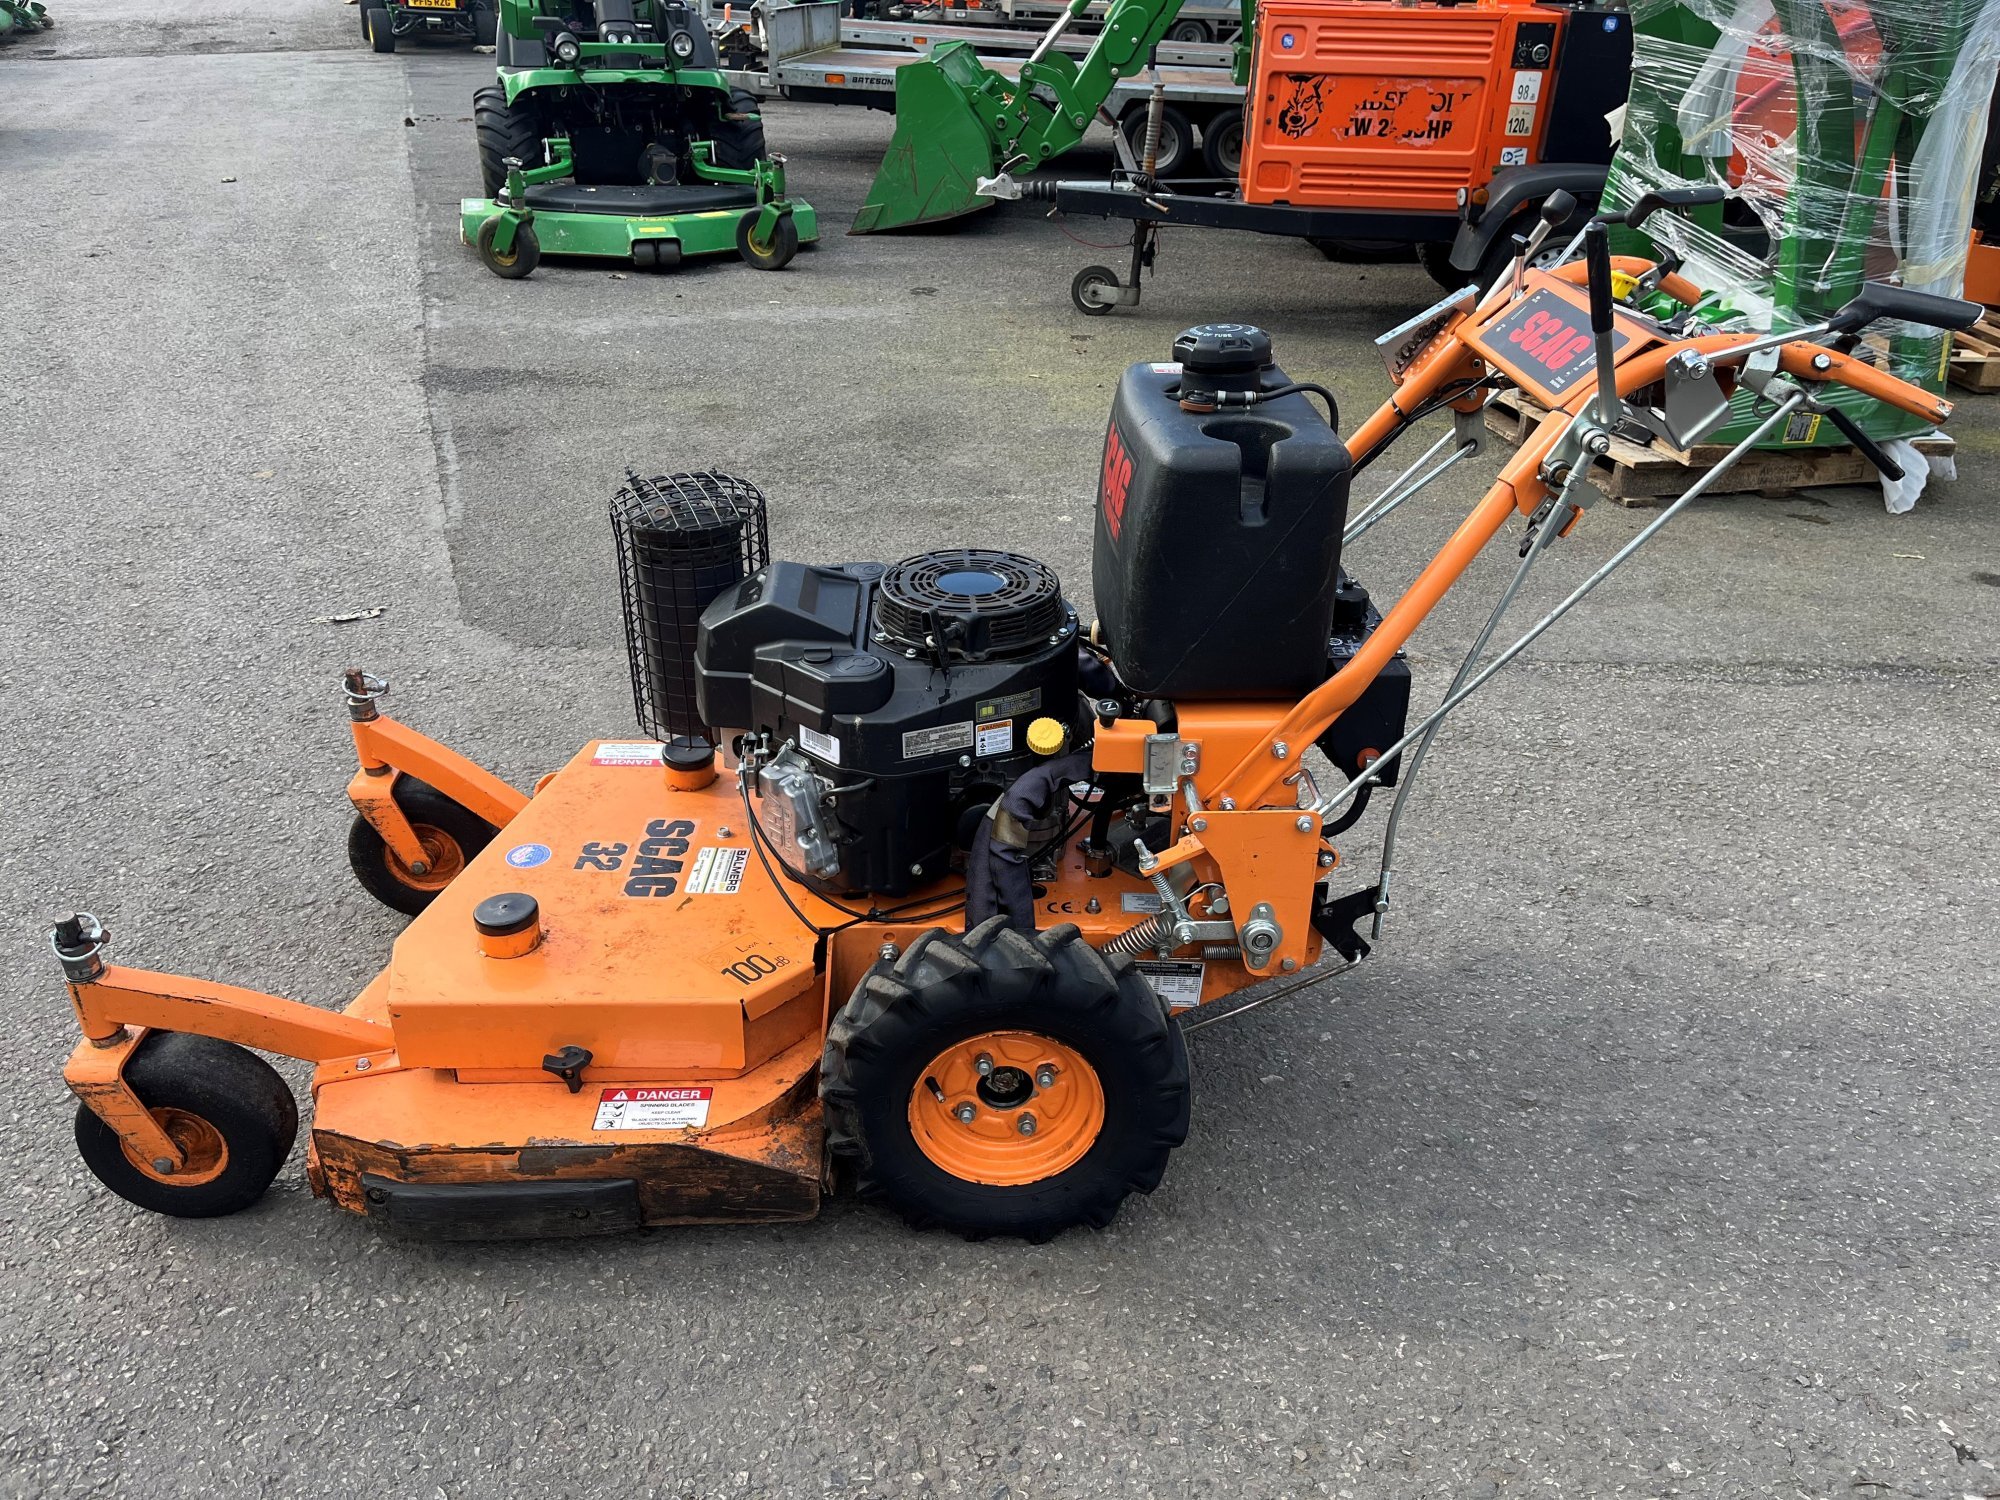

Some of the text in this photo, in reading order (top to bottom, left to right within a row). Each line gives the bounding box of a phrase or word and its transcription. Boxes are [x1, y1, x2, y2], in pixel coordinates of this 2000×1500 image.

[852, 76, 894, 85] BATESON
[1517, 84, 1530, 100] 98
[1508, 117, 1525, 133] 120
[1508, 310, 1592, 370] SCAG
[573, 842, 628, 871] 32
[624, 819, 696, 898] SCAG
[725, 849, 747, 892] BALMERS
[720, 954, 791, 986] 100 dB
[636, 1090, 701, 1100] DANGER
